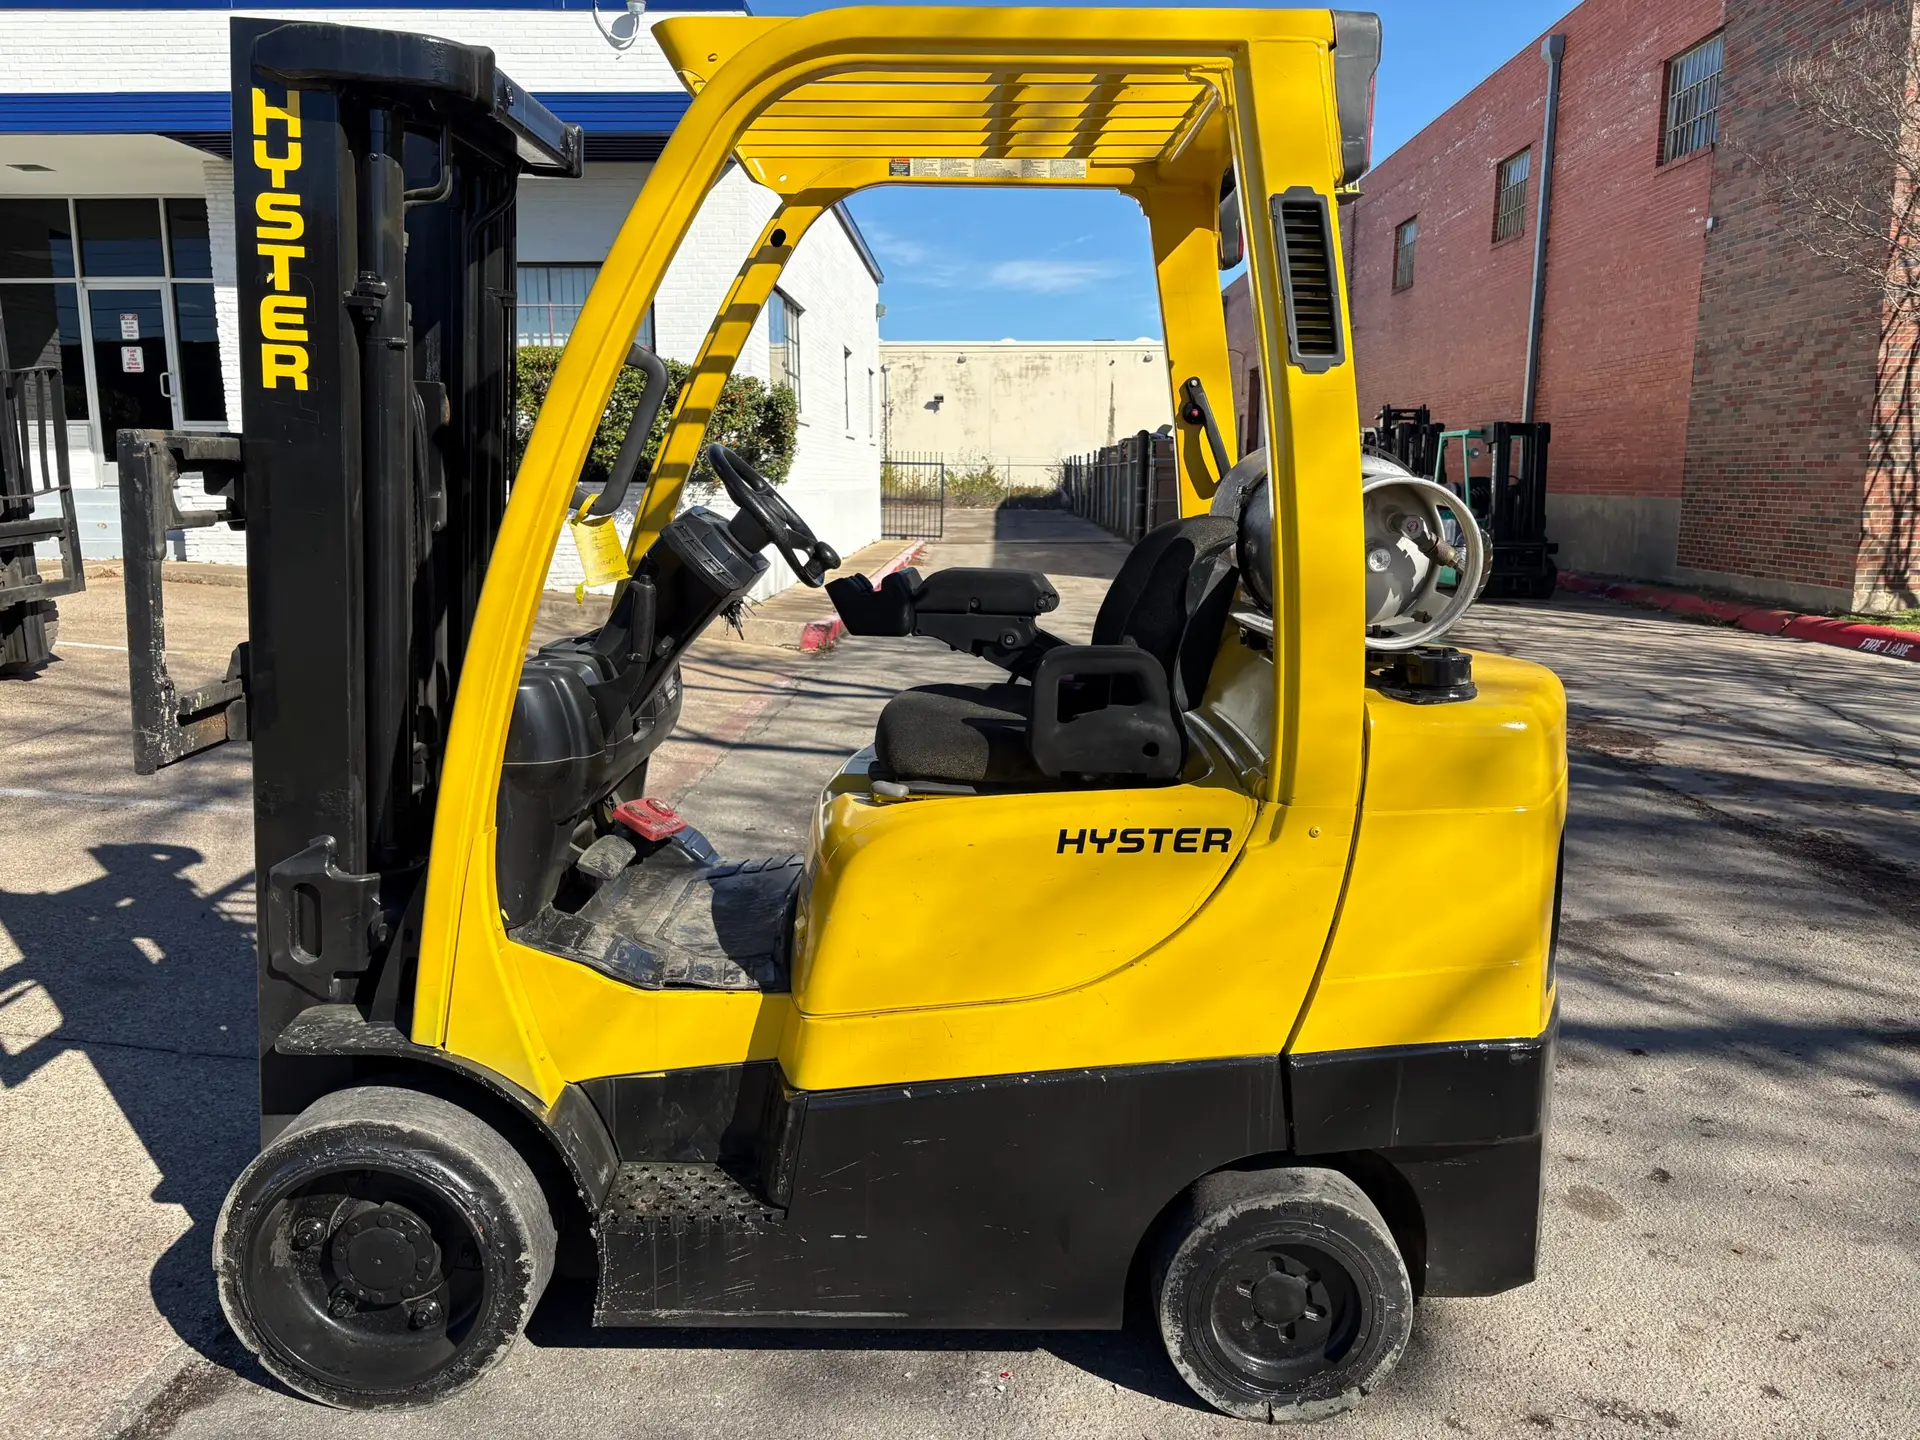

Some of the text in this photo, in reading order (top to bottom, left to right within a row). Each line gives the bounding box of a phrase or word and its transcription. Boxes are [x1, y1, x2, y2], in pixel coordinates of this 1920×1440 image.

[251, 87, 309, 391] HYSTER
[1858, 638, 1914, 657] FIRE LANE
[1056, 827, 1233, 854] HYSTER
